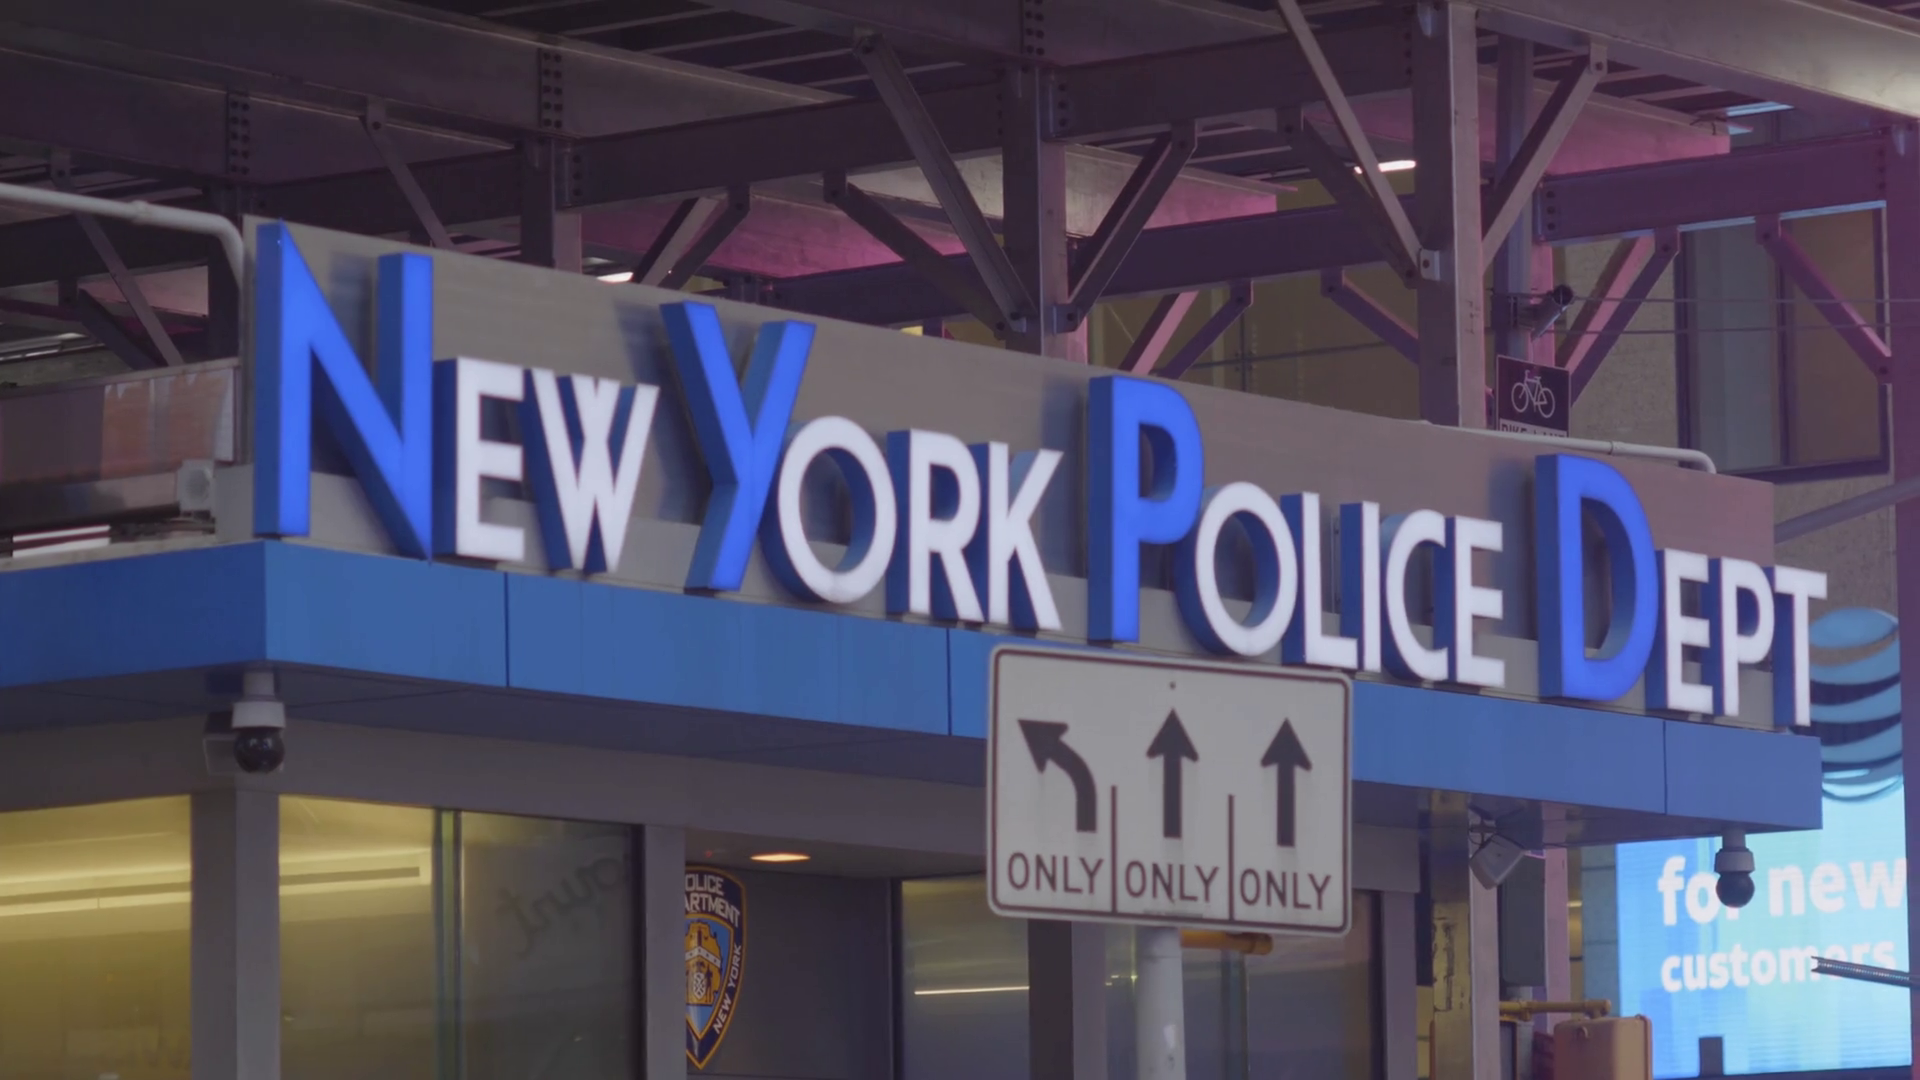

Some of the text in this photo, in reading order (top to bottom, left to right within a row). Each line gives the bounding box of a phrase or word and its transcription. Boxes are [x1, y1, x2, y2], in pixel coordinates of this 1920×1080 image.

[255, 221, 1828, 727] NEW YORK POLICE DEPT
[684, 892, 741, 928] RTMENT
[685, 873, 724, 896] OLICE
[1007, 851, 1332, 911] ONLY ONLY ONLY
[1657, 855, 1908, 926] fo new
[712, 942, 742, 1035] NEW YORK
[1660, 941, 1897, 993] customers
